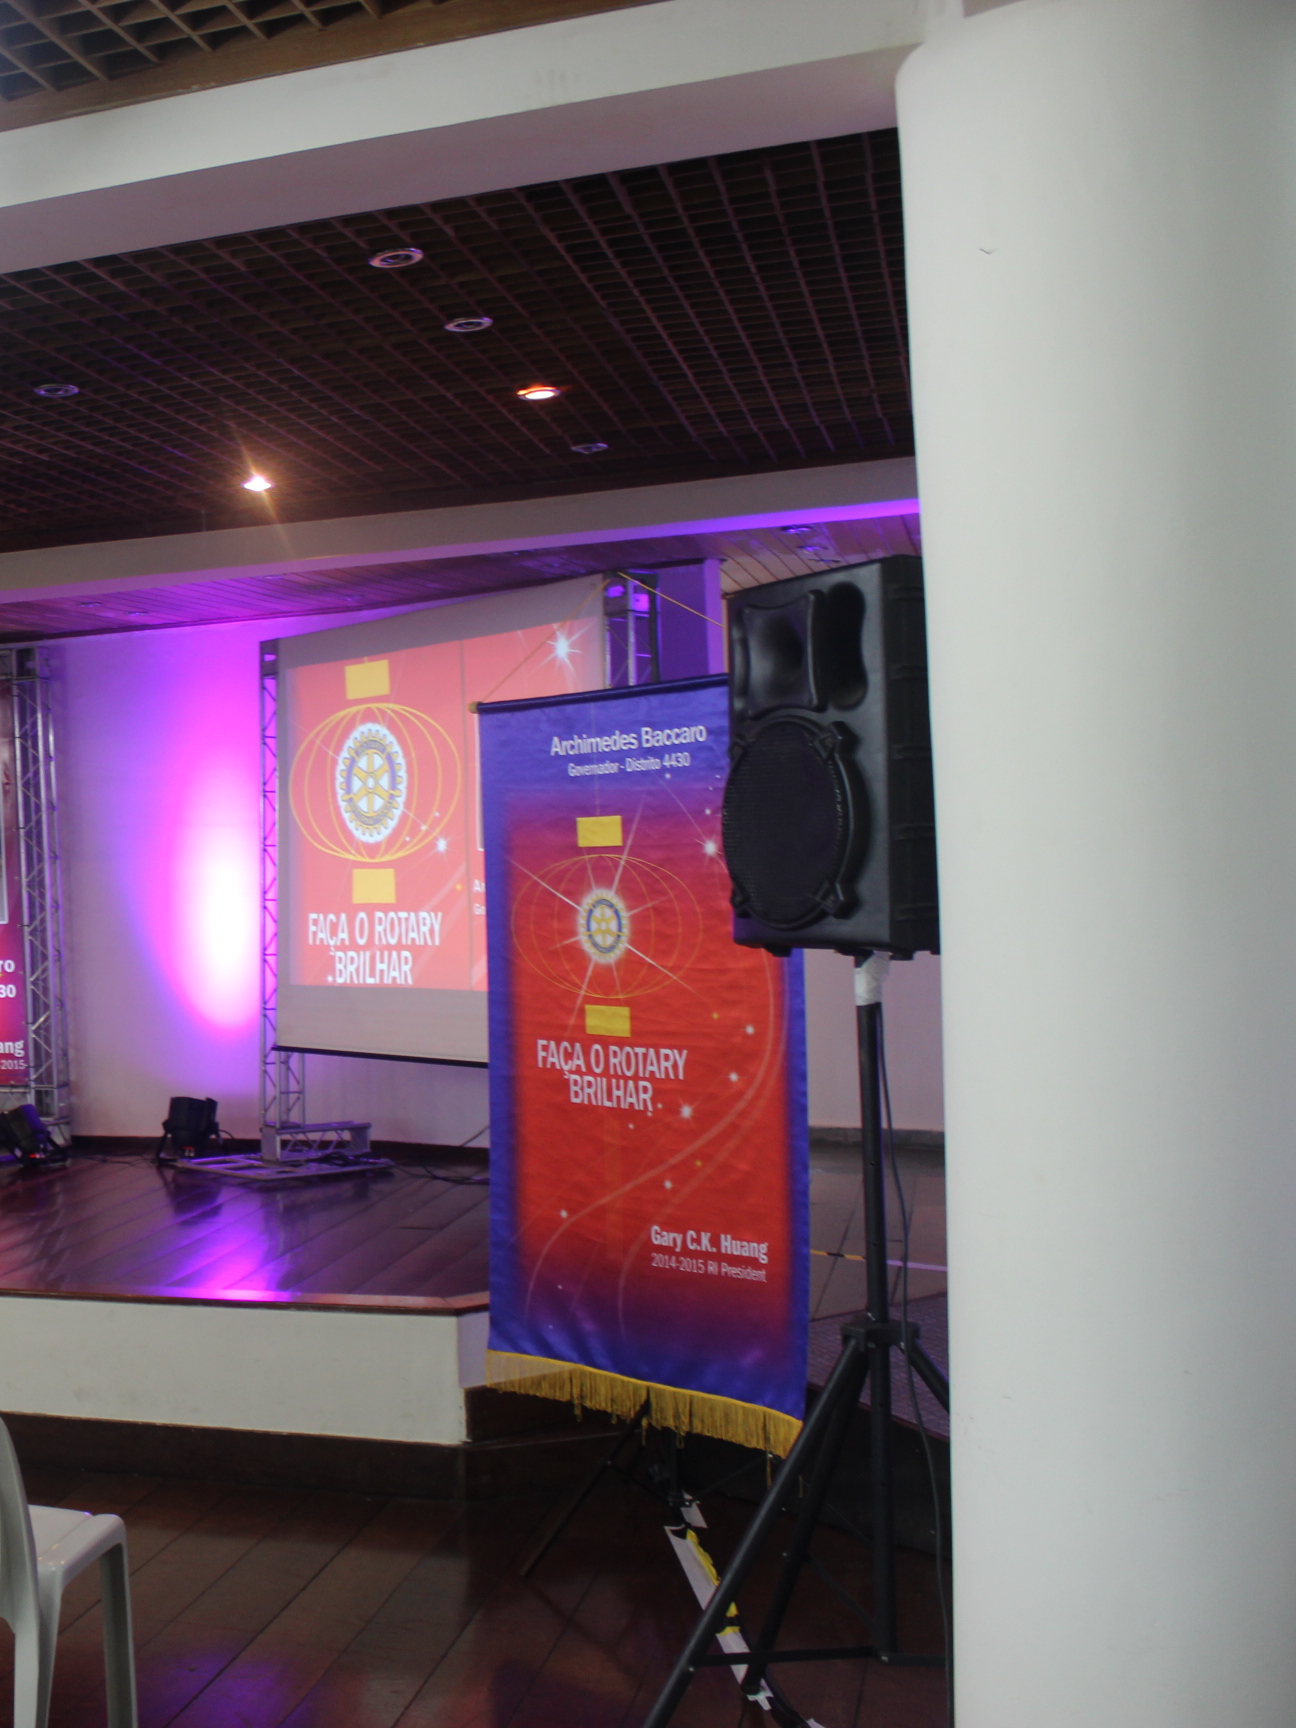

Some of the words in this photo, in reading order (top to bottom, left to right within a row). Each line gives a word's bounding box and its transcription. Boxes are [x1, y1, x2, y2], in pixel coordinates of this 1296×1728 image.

[550, 730, 639, 756] Archimedes
[641, 725, 707, 748] Baccaro
[568, 761, 620, 776] Governador
[625, 756, 661, 772] Distrito
[663, 752, 691, 768] 4430
[308, 912, 350, 955] FAÇA
[355, 911, 369, 946] O
[374, 911, 442, 946] ROTARY
[335, 950, 413, 985] BRILHAR
[537, 1039, 586, 1079] FAÇA
[590, 1043, 604, 1074] O
[609, 1045, 688, 1080] ROTARY
[569, 1074, 653, 1111] BRILHAR
[650, 1225, 683, 1252] Gary
[686, 1230, 717, 1253] C.K.
[720, 1233, 769, 1264] Huang
[651, 1252, 705, 1274] 2014-2015
[707, 1260, 718, 1275] RI
[721, 1262, 767, 1282] President
